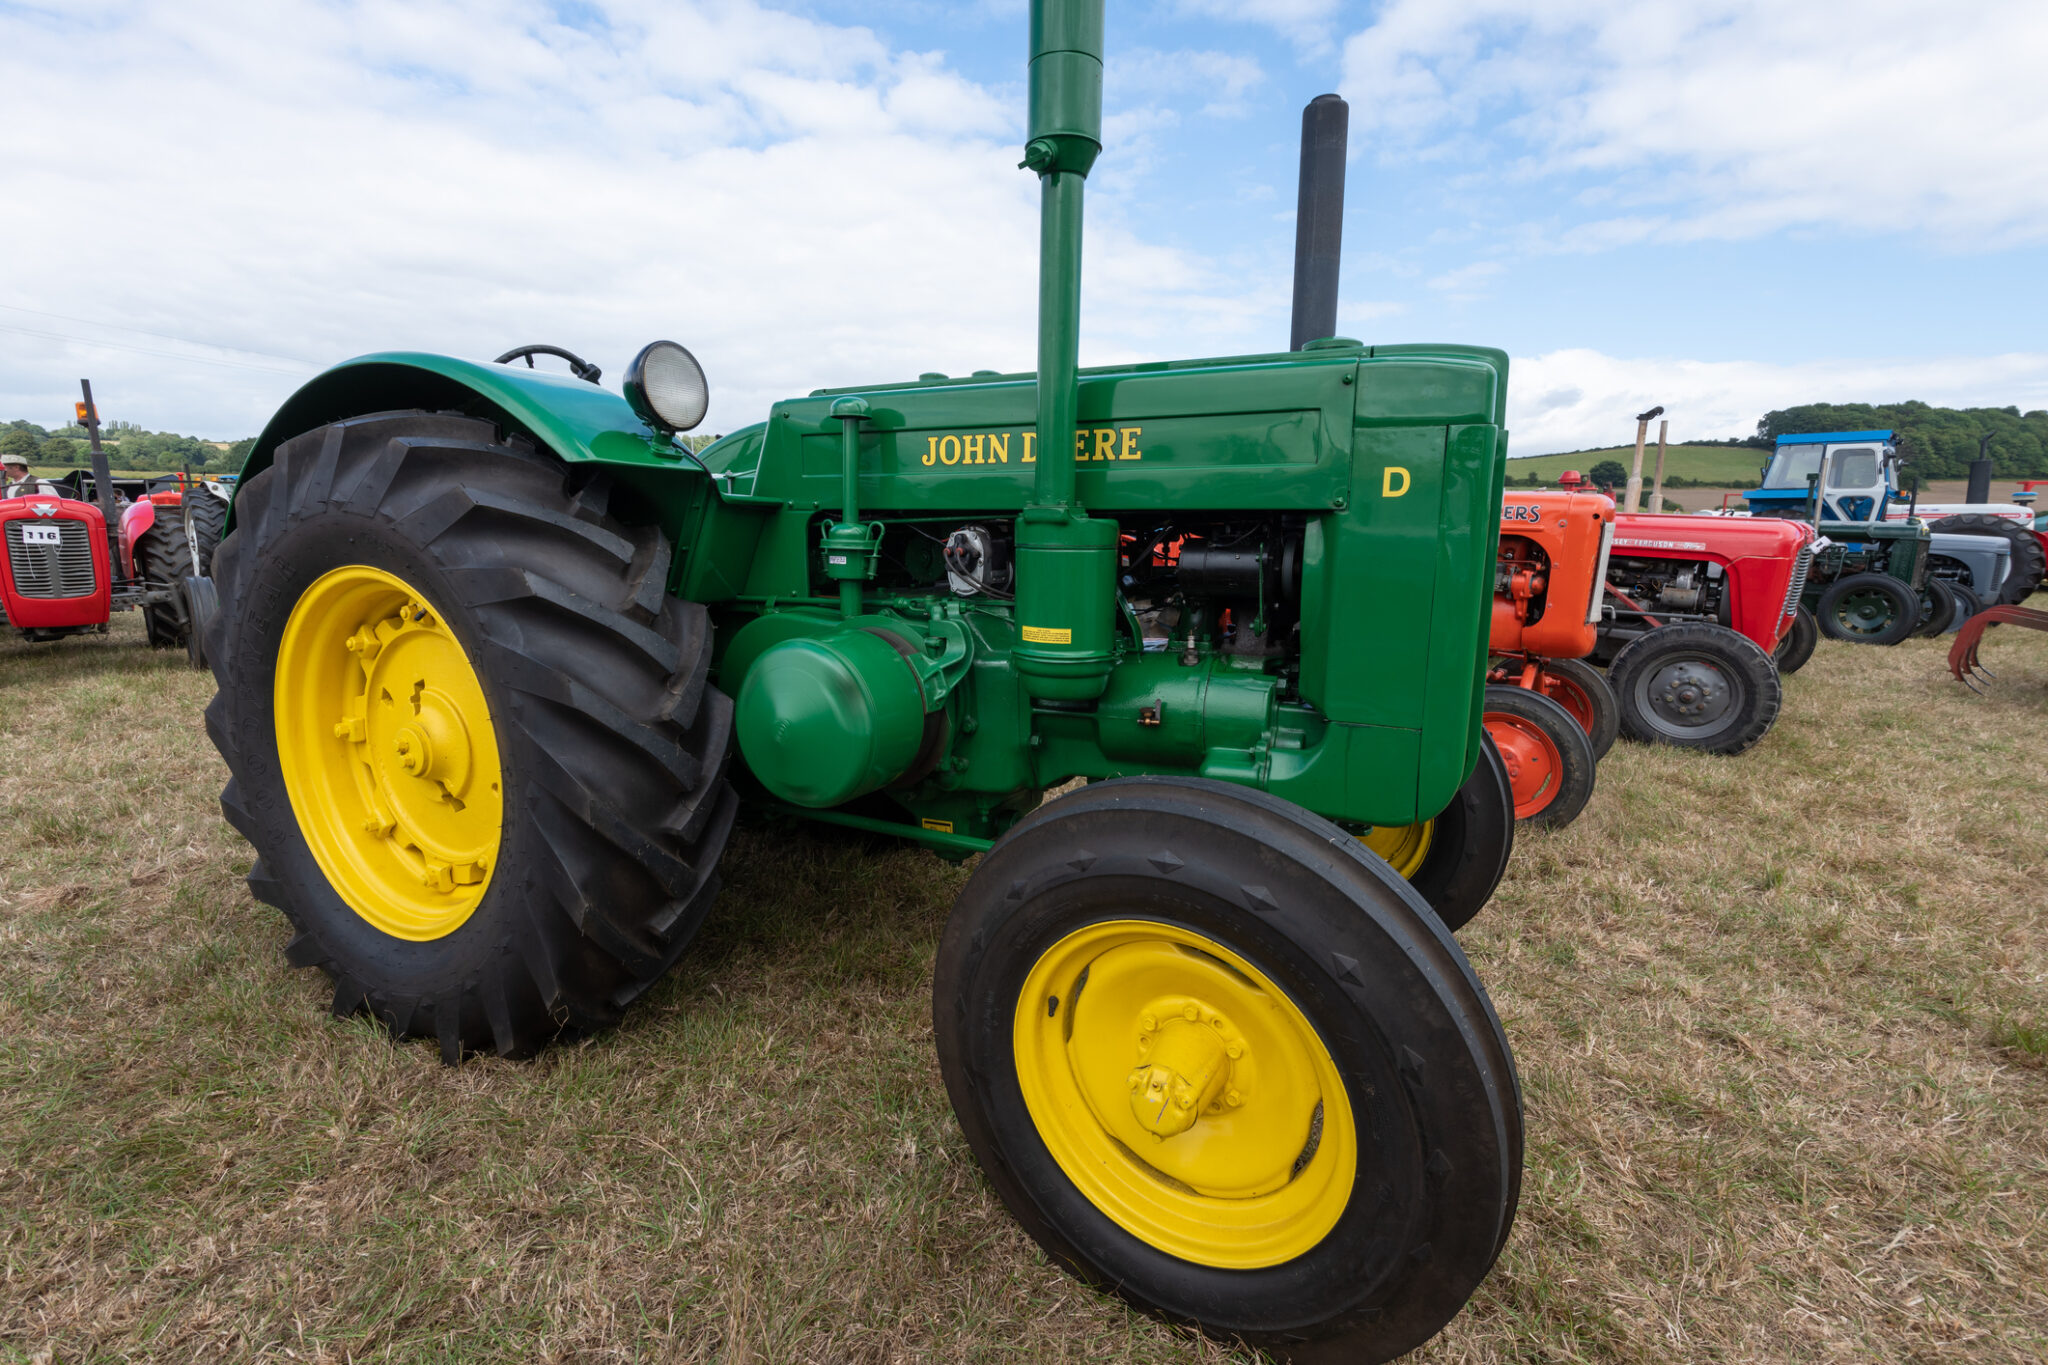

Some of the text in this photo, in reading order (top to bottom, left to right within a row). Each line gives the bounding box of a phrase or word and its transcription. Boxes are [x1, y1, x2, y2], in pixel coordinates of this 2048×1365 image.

[921, 427, 1142, 466] JOHN DERE
[1382, 466, 1411, 498] D
[26, 531, 57, 540] 116
